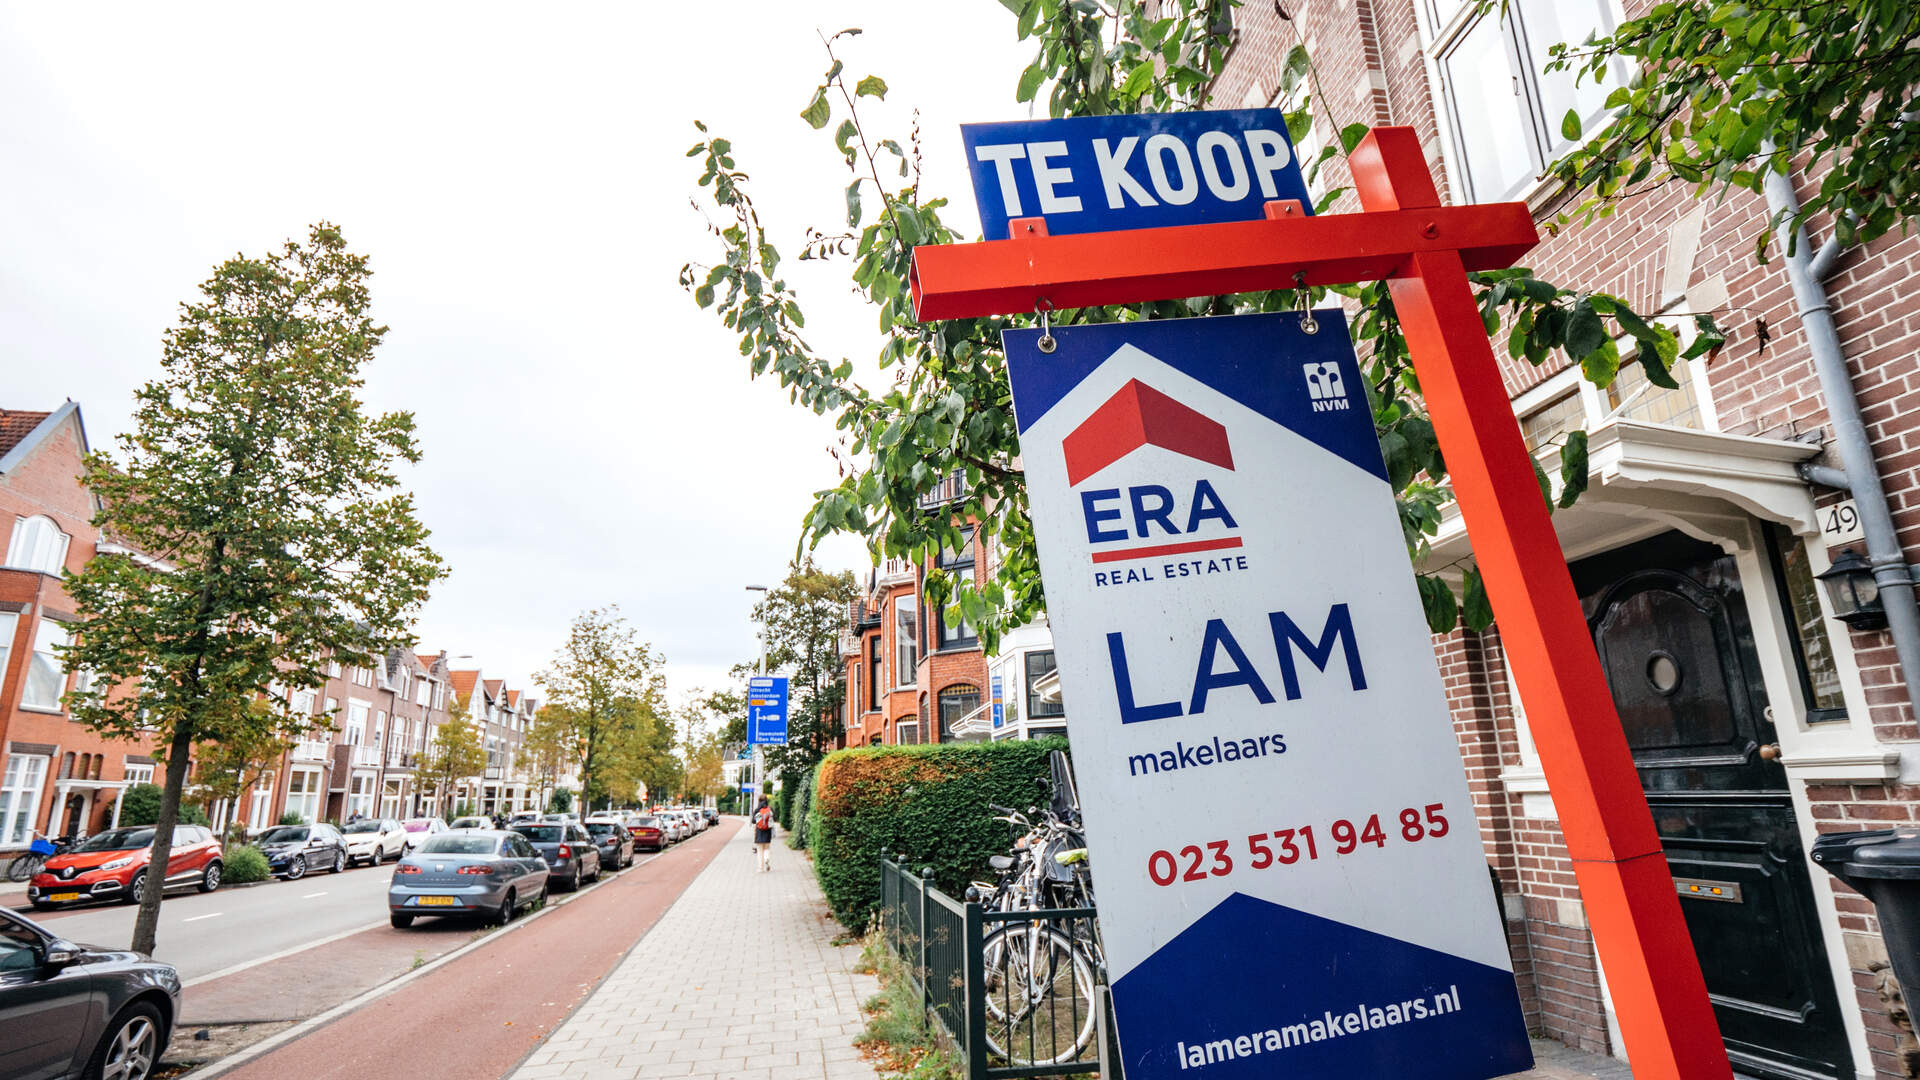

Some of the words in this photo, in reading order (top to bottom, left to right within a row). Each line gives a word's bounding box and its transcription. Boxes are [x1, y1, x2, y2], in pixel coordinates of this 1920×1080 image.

[974, 140, 1084, 218] TE
[1091, 129, 1292, 210] KOOP
[1311, 398, 1350, 413] NVM
[1080, 479, 1239, 544] ERA
[1826, 505, 1858, 534] 49
[1095, 567, 1154, 587] REAL
[1163, 555, 1249, 579] ESTATE
[1106, 603, 1368, 725] LAM
[1128, 733, 1287, 777] makelaars
[1148, 839, 1234, 887] 023
[1247, 825, 1319, 870] 531
[1331, 814, 1387, 855] 94
[1400, 803, 1449, 843] 85
[1177, 984, 1463, 1070] lameramakelaars.nl
